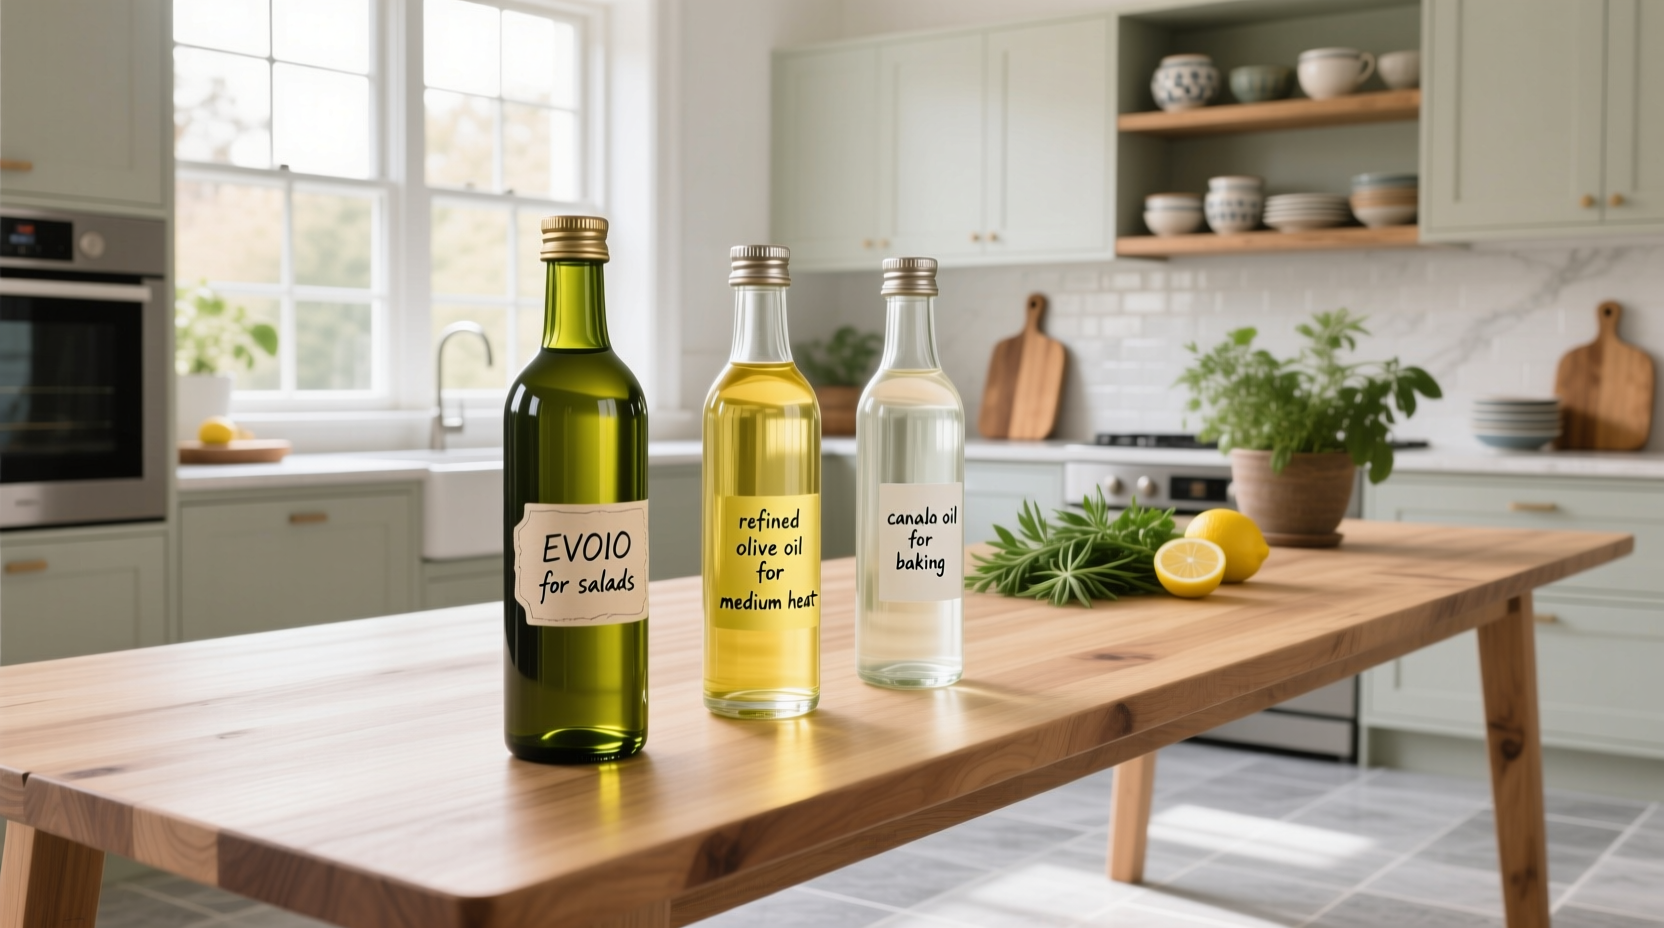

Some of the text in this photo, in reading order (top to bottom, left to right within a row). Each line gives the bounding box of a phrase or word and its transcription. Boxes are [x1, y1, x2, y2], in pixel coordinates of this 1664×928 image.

[739, 508, 800, 532] refined
[942, 505, 957, 525] oil
[736, 536, 803, 556] olive oil
[908, 529, 933, 549] for
[756, 560, 785, 584] for
[896, 551, 945, 577] baking
[538, 568, 635, 605] for salads
[719, 589, 819, 610] medium heat
